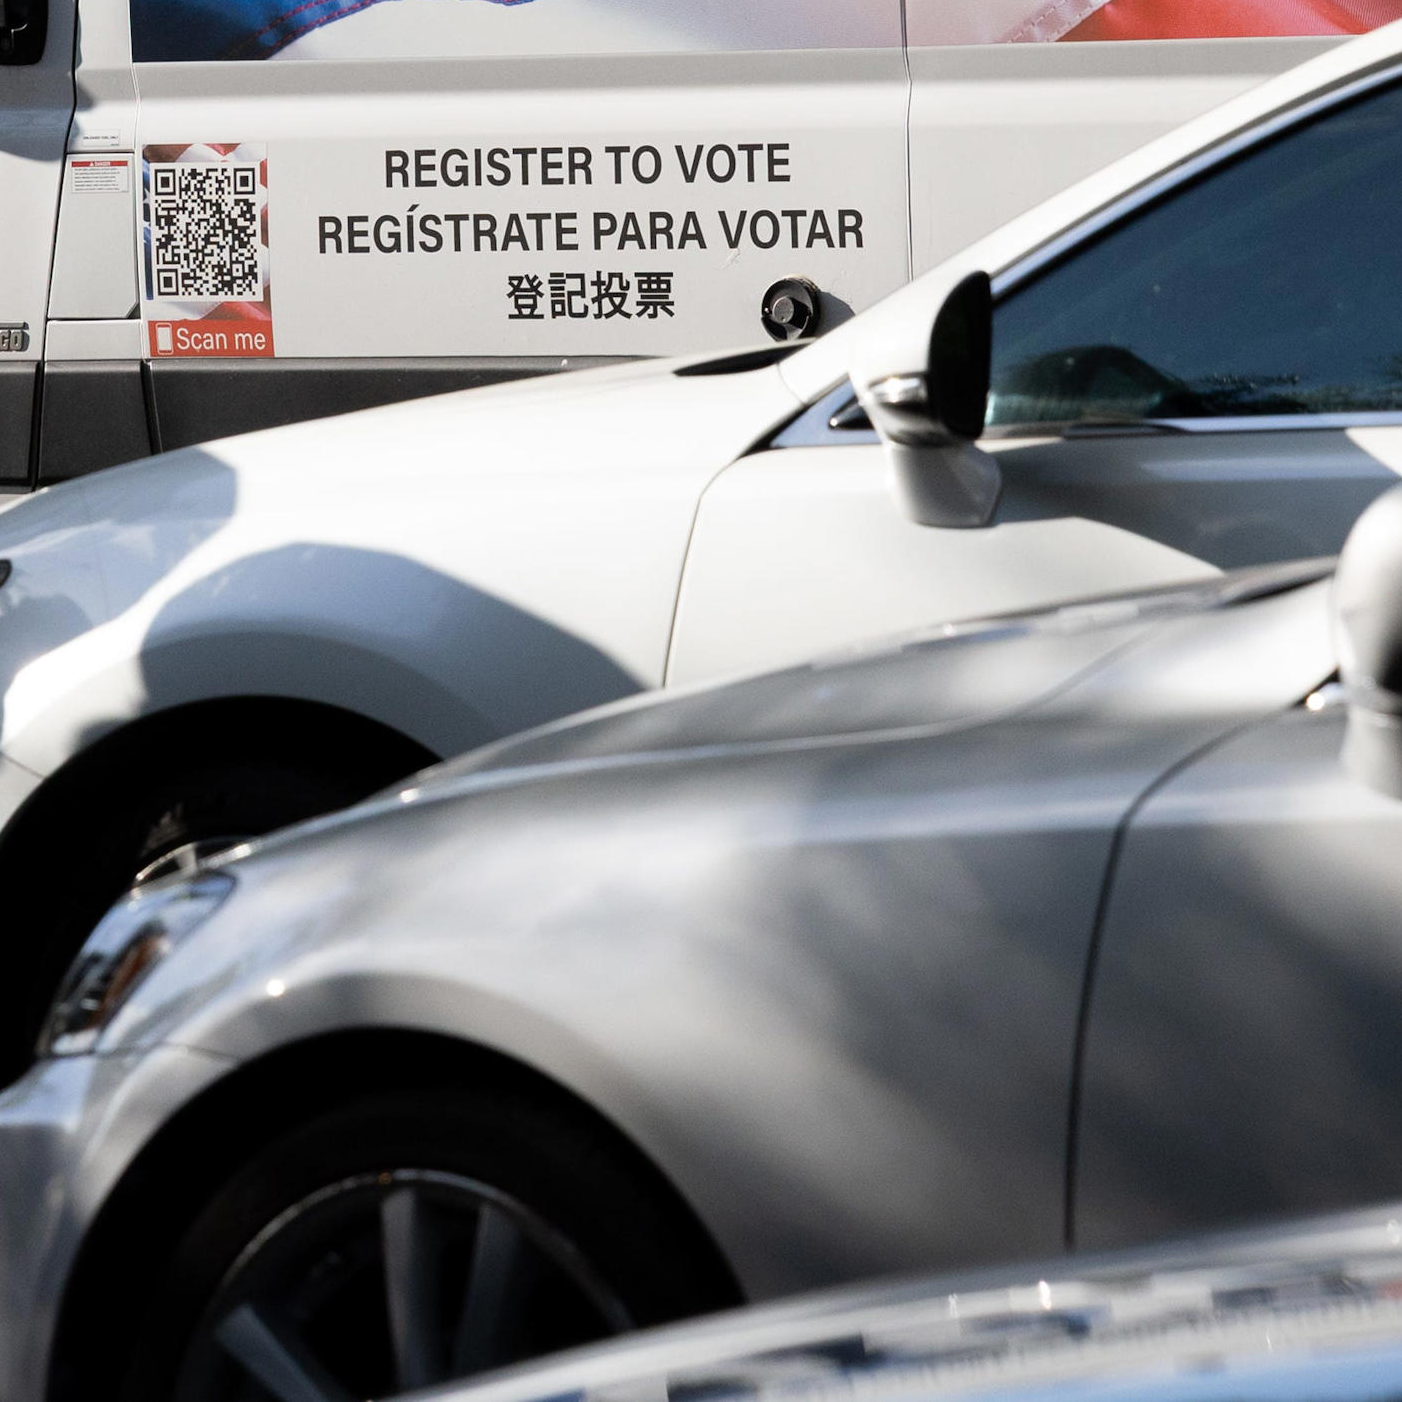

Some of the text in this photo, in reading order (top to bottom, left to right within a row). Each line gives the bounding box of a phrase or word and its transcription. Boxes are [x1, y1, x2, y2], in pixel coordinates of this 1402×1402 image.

[386, 143, 791, 188] REGISTER TO VOTE
[319, 203, 864, 254] REGÍSTRATE PARA VOTAR
[506, 271, 675, 320] 登記投票
[176, 327, 266, 350] Scan me
